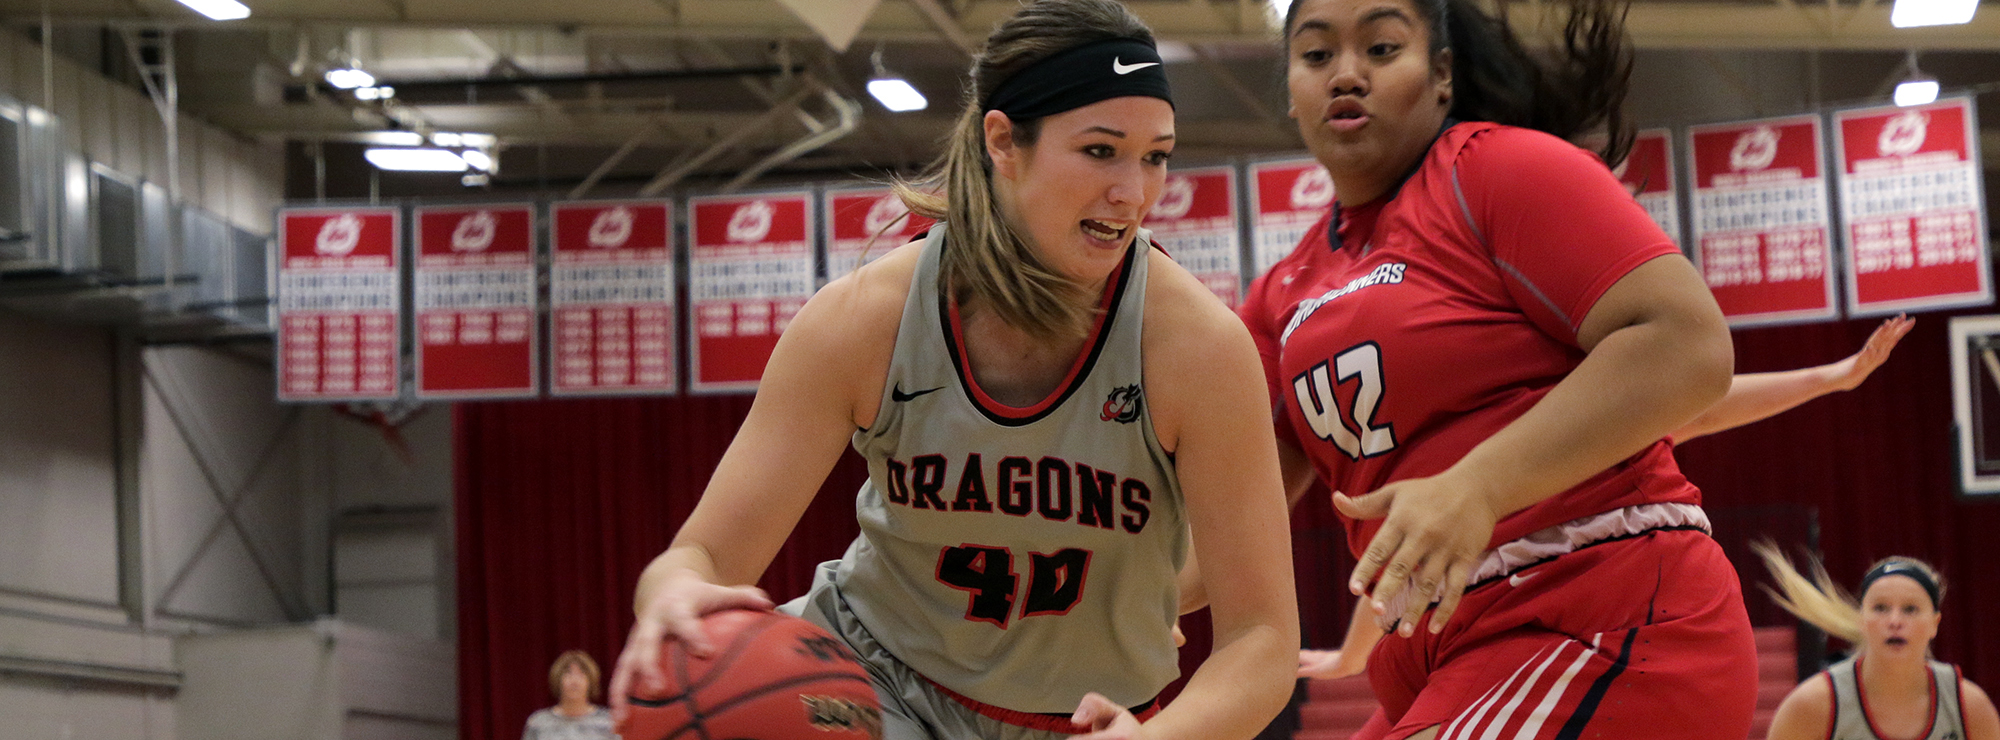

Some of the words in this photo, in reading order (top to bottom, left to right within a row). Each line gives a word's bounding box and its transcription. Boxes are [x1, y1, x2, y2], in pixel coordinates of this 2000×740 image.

[1292, 339, 1400, 462] 42
[886, 452, 1152, 535] DRAGONS
[934, 542, 1095, 631] 40
